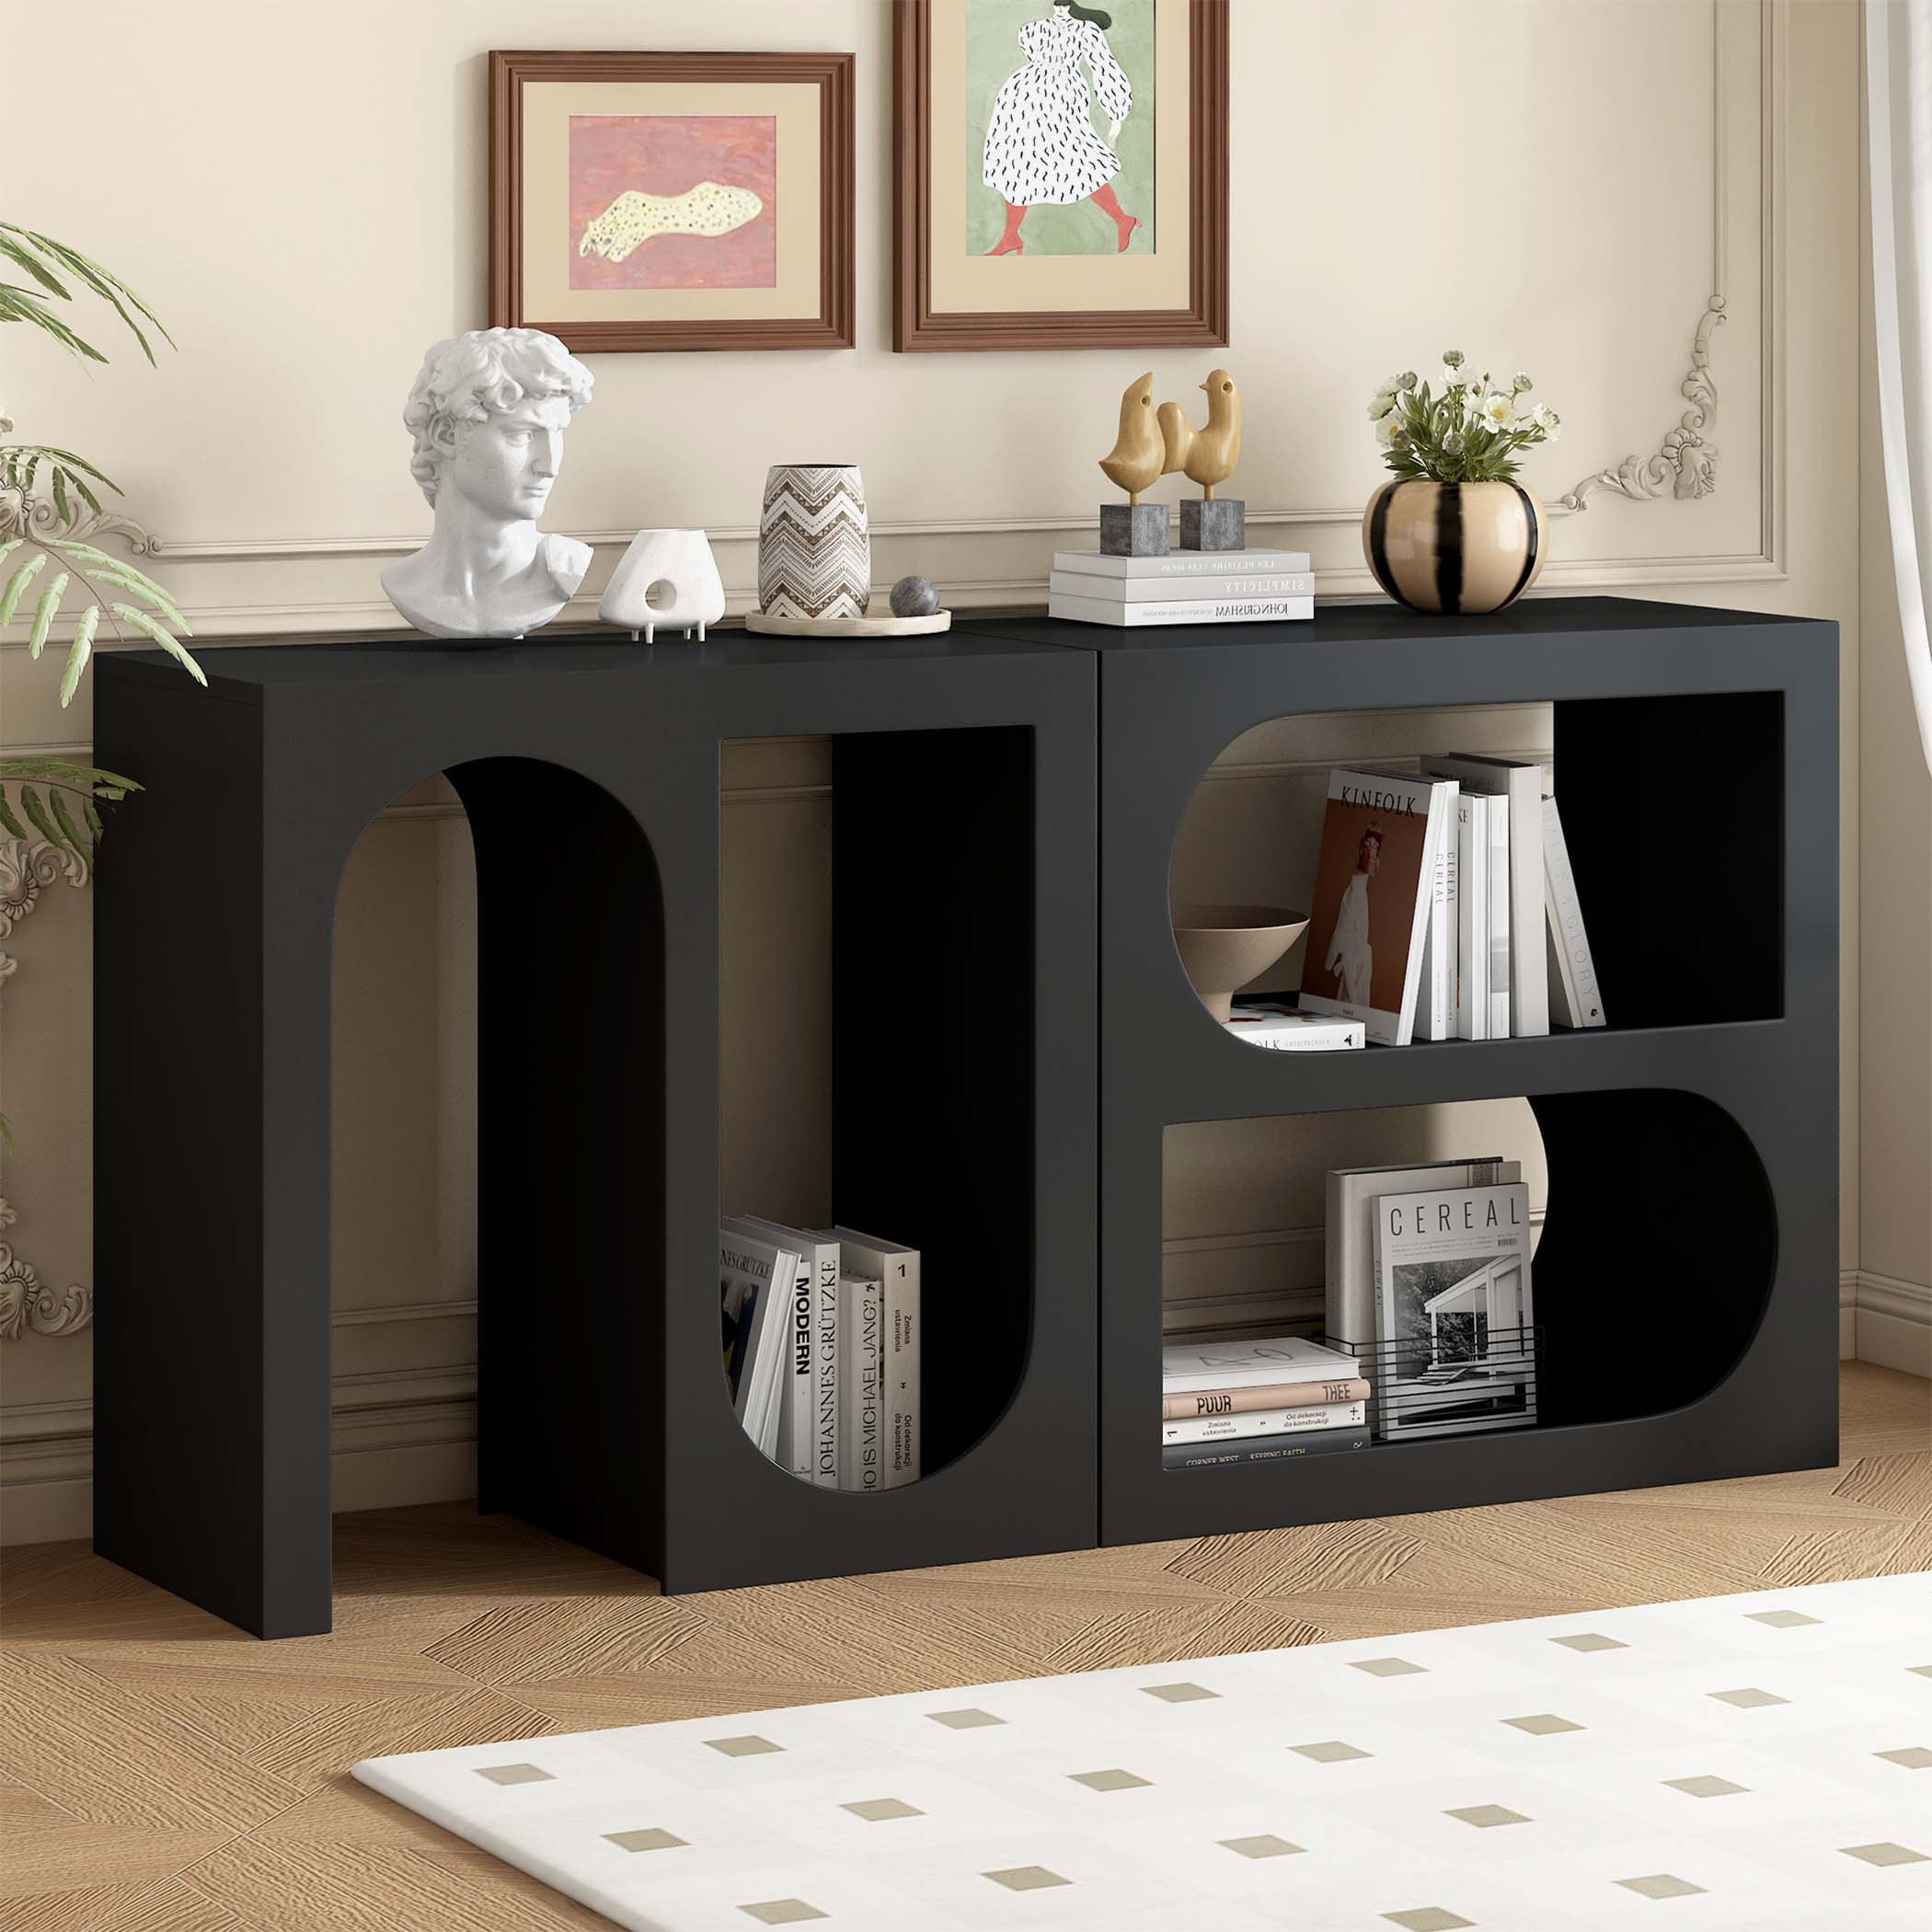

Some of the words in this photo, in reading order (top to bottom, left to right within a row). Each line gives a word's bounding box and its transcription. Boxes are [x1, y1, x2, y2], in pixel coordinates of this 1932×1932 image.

[1340, 787, 1416, 817] KINFOLK
[1447, 852, 1455, 903] CEREAL
[1390, 1198, 1520, 1236] CEREAL
[898, 1264, 905, 1277] 1
[796, 1277, 811, 1375] MODERN
[818, 1260, 836, 1361] GRÜTZKE
[863, 1300, 877, 1359] JANG?
[894, 1310, 903, 1353] ustawienia
[863, 1361, 877, 1444] MICHAEL
[1196, 1395, 1232, 1414] PUUR
[1322, 1384, 1351, 1400] THEE
[820, 1365, 836, 1477] JOHANNES
[894, 1413, 903, 1423] do
[904, 1415, 912, 1427] Od
[863, 1449, 877, 1466] IS
[903, 1429, 912, 1466] dekoracji
